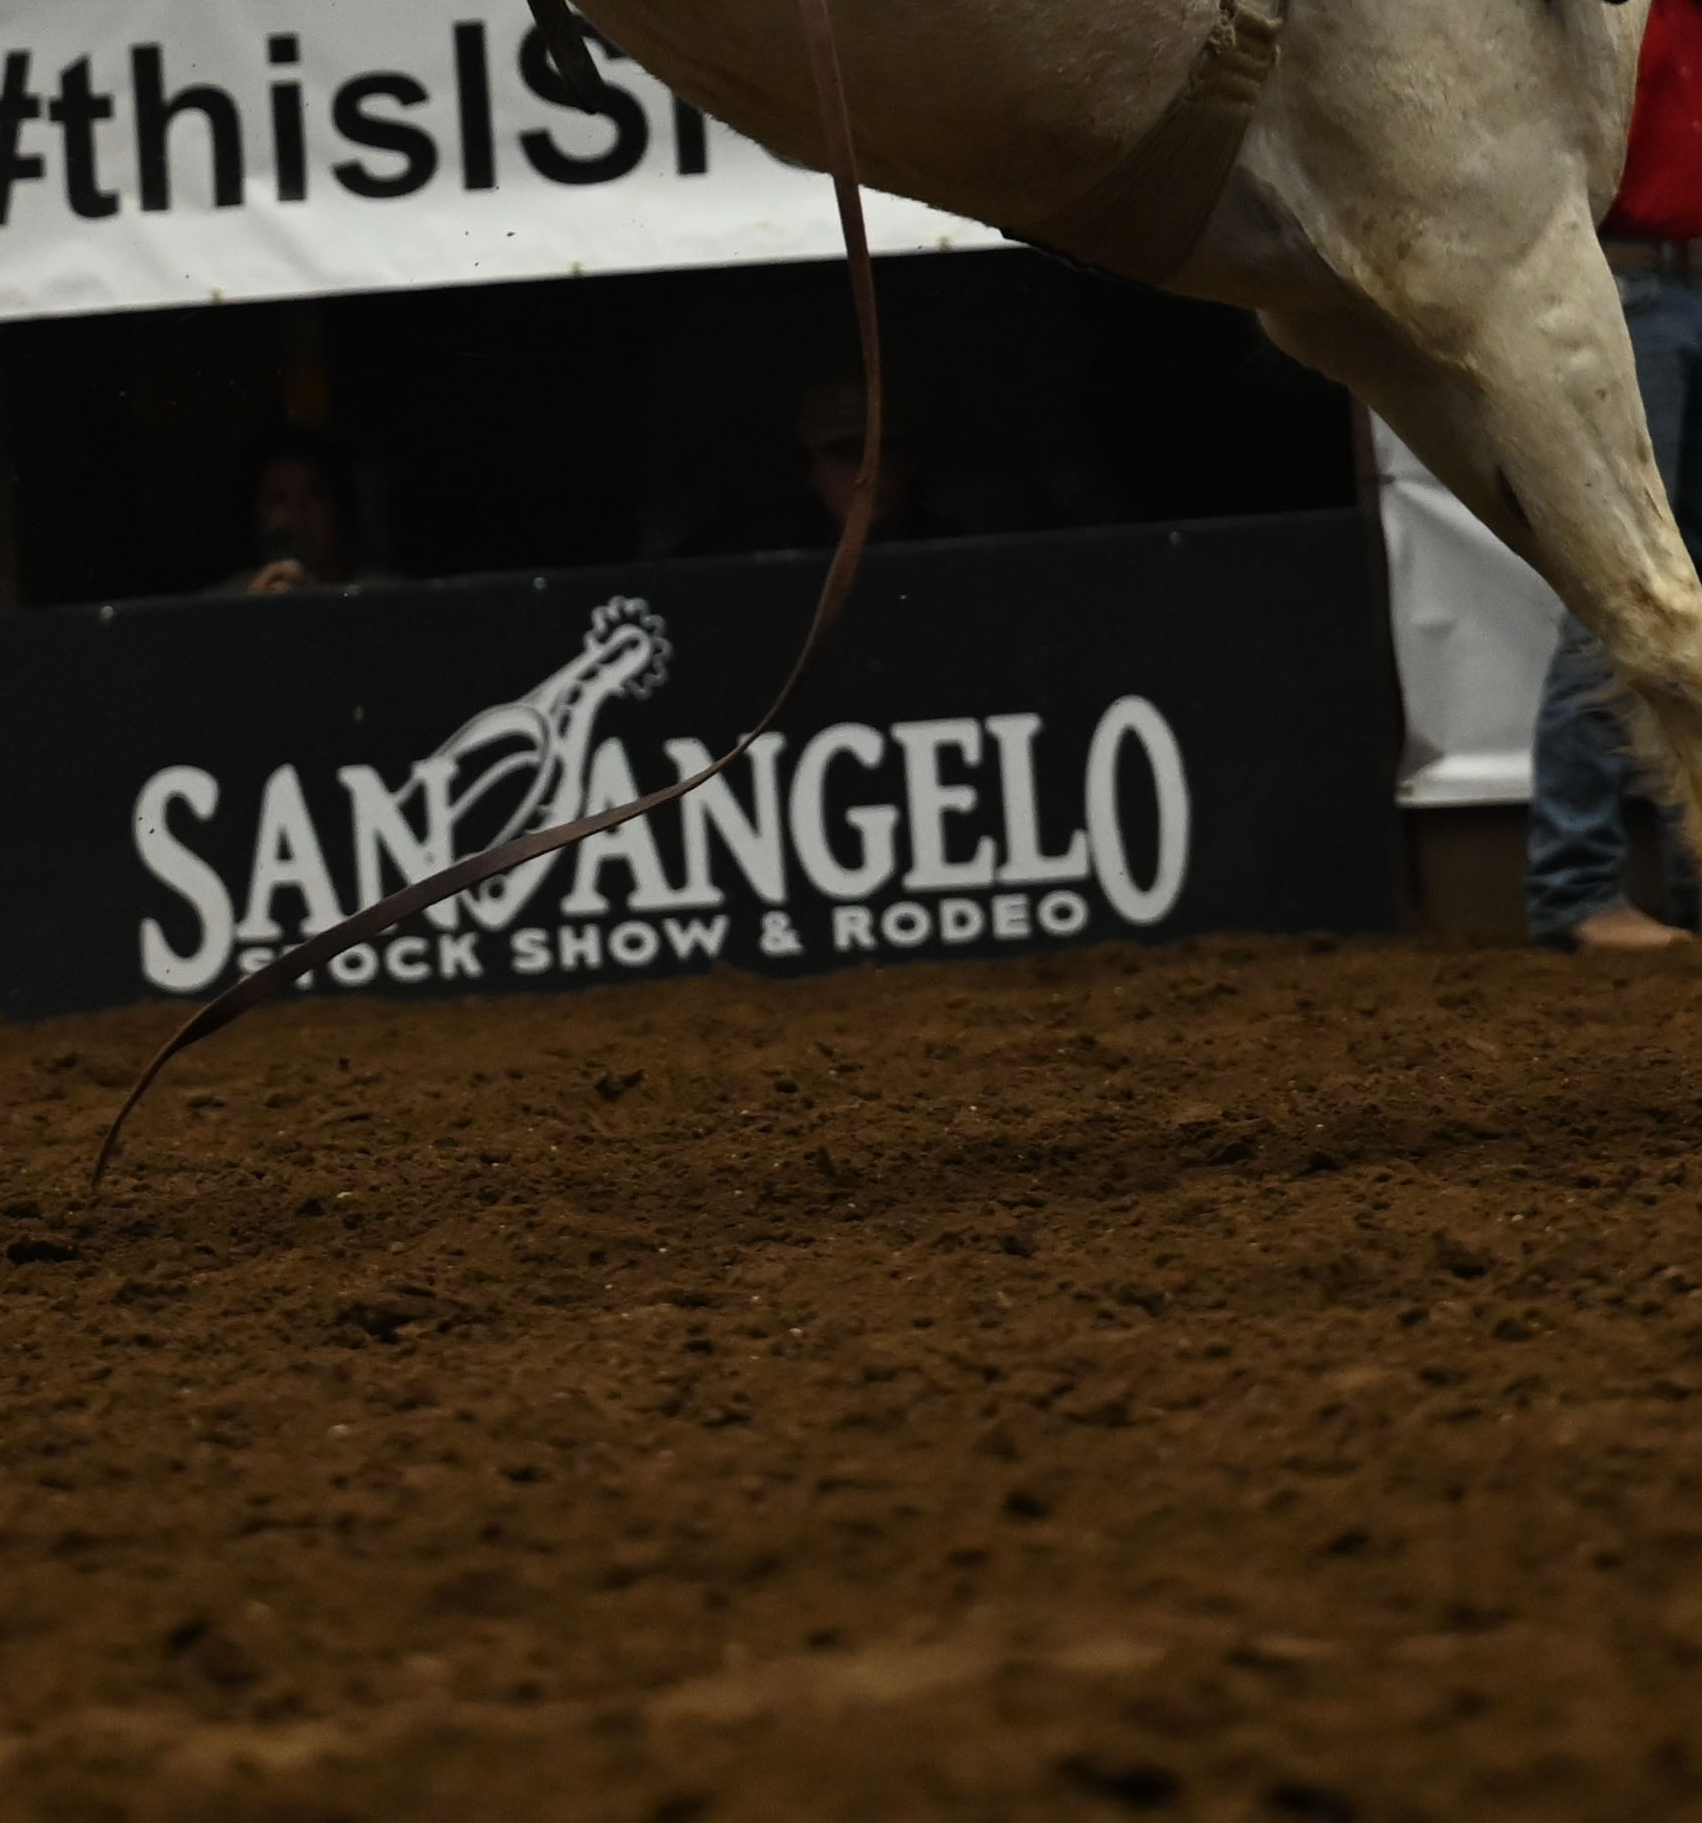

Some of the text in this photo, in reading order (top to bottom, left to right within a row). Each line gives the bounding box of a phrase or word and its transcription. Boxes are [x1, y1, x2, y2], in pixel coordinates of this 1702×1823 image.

[132, 694, 1192, 994] SAN ANGELO
[510, 914, 731, 978] SHOW
[758, 909, 805, 957] &
[831, 889, 1091, 953] RODEO
